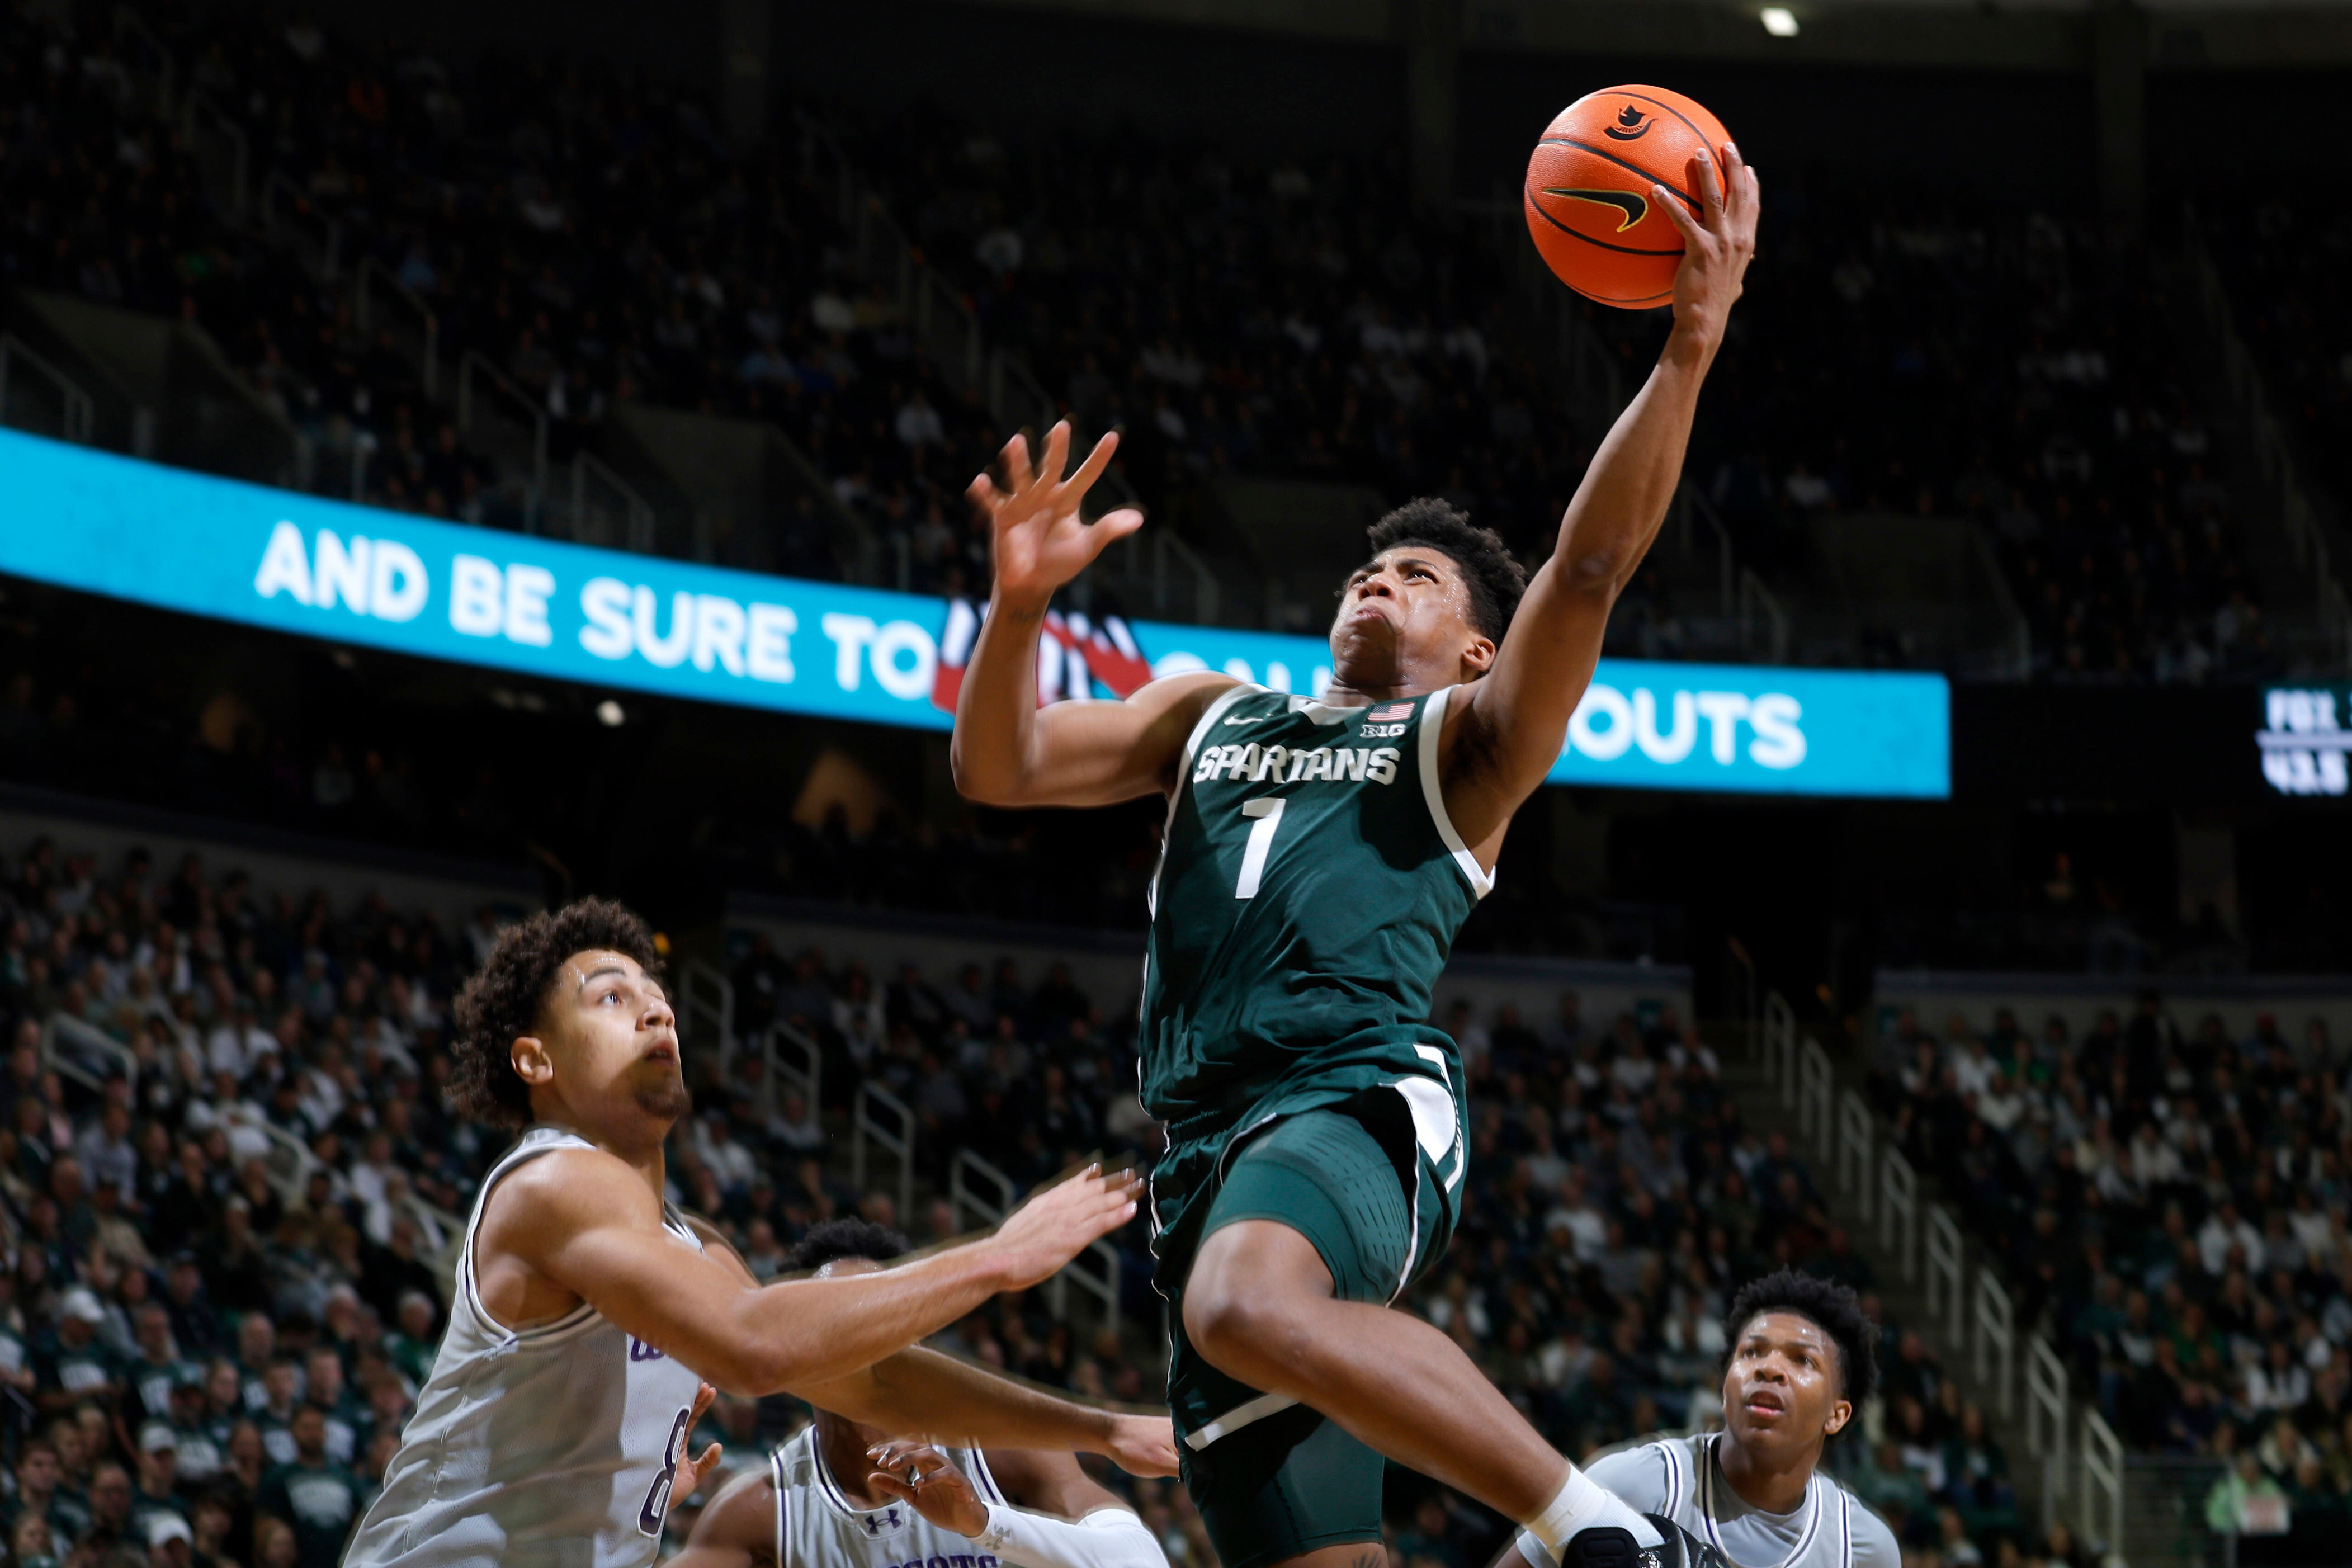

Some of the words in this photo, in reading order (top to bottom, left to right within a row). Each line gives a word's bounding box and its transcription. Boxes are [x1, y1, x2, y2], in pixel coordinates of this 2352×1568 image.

[256, 522, 429, 622] AND
[450, 554, 555, 646] BE
[579, 578, 797, 683] SURE
[822, 613, 938, 701] TO
[1193, 743, 1400, 785] SPARTANS
[1562, 683, 1807, 769] OUTS
[1235, 797, 1286, 899] 1
